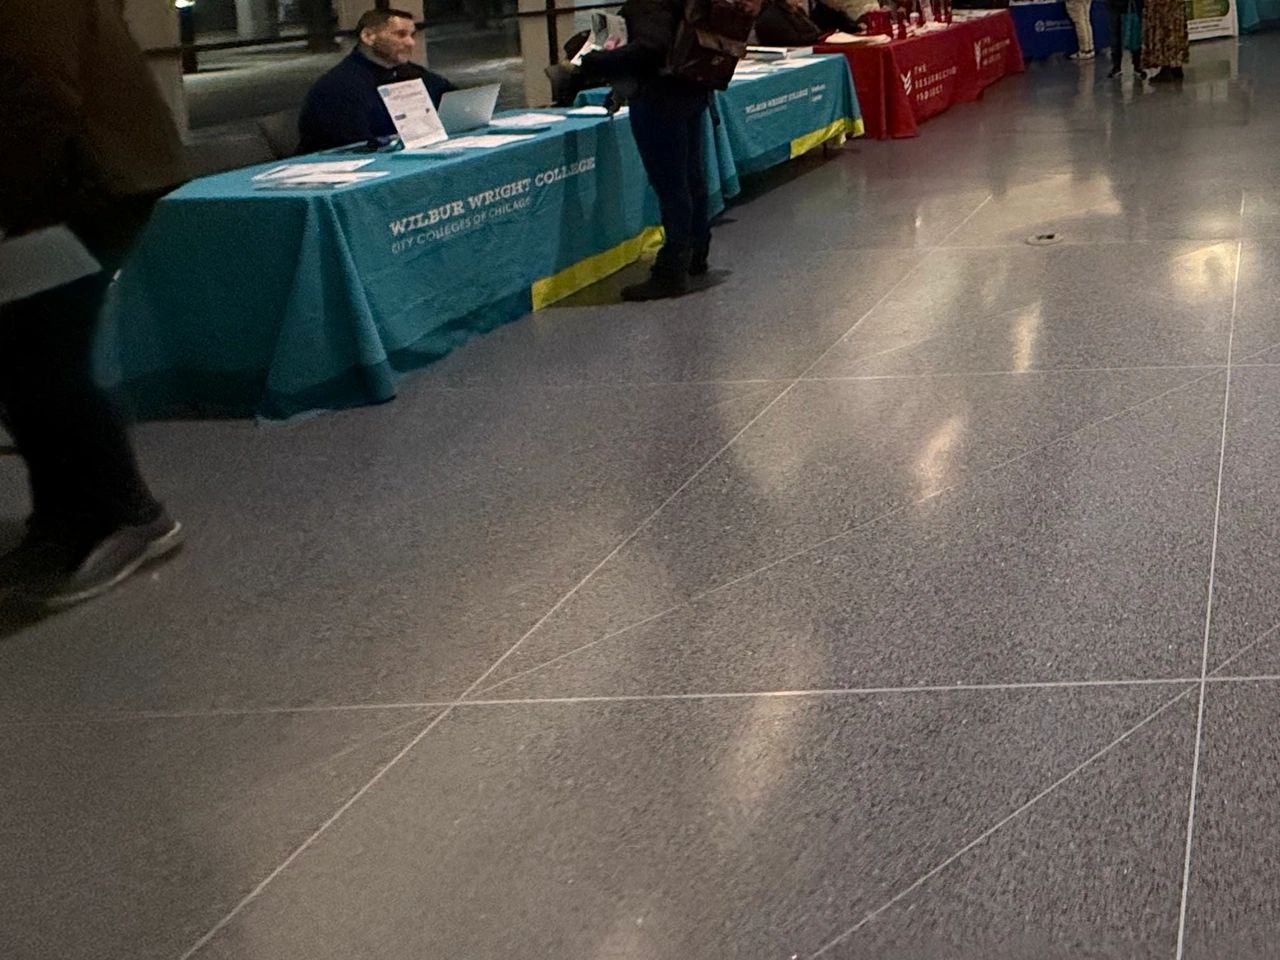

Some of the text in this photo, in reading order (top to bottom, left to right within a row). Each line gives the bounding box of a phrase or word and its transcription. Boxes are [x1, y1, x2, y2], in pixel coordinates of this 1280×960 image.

[388, 156, 596, 237] WILBUR WRIGHT COLLEGE
[391, 237, 414, 255] CITY
[416, 218, 472, 246] COLLEGES
[472, 212, 487, 225] OF
